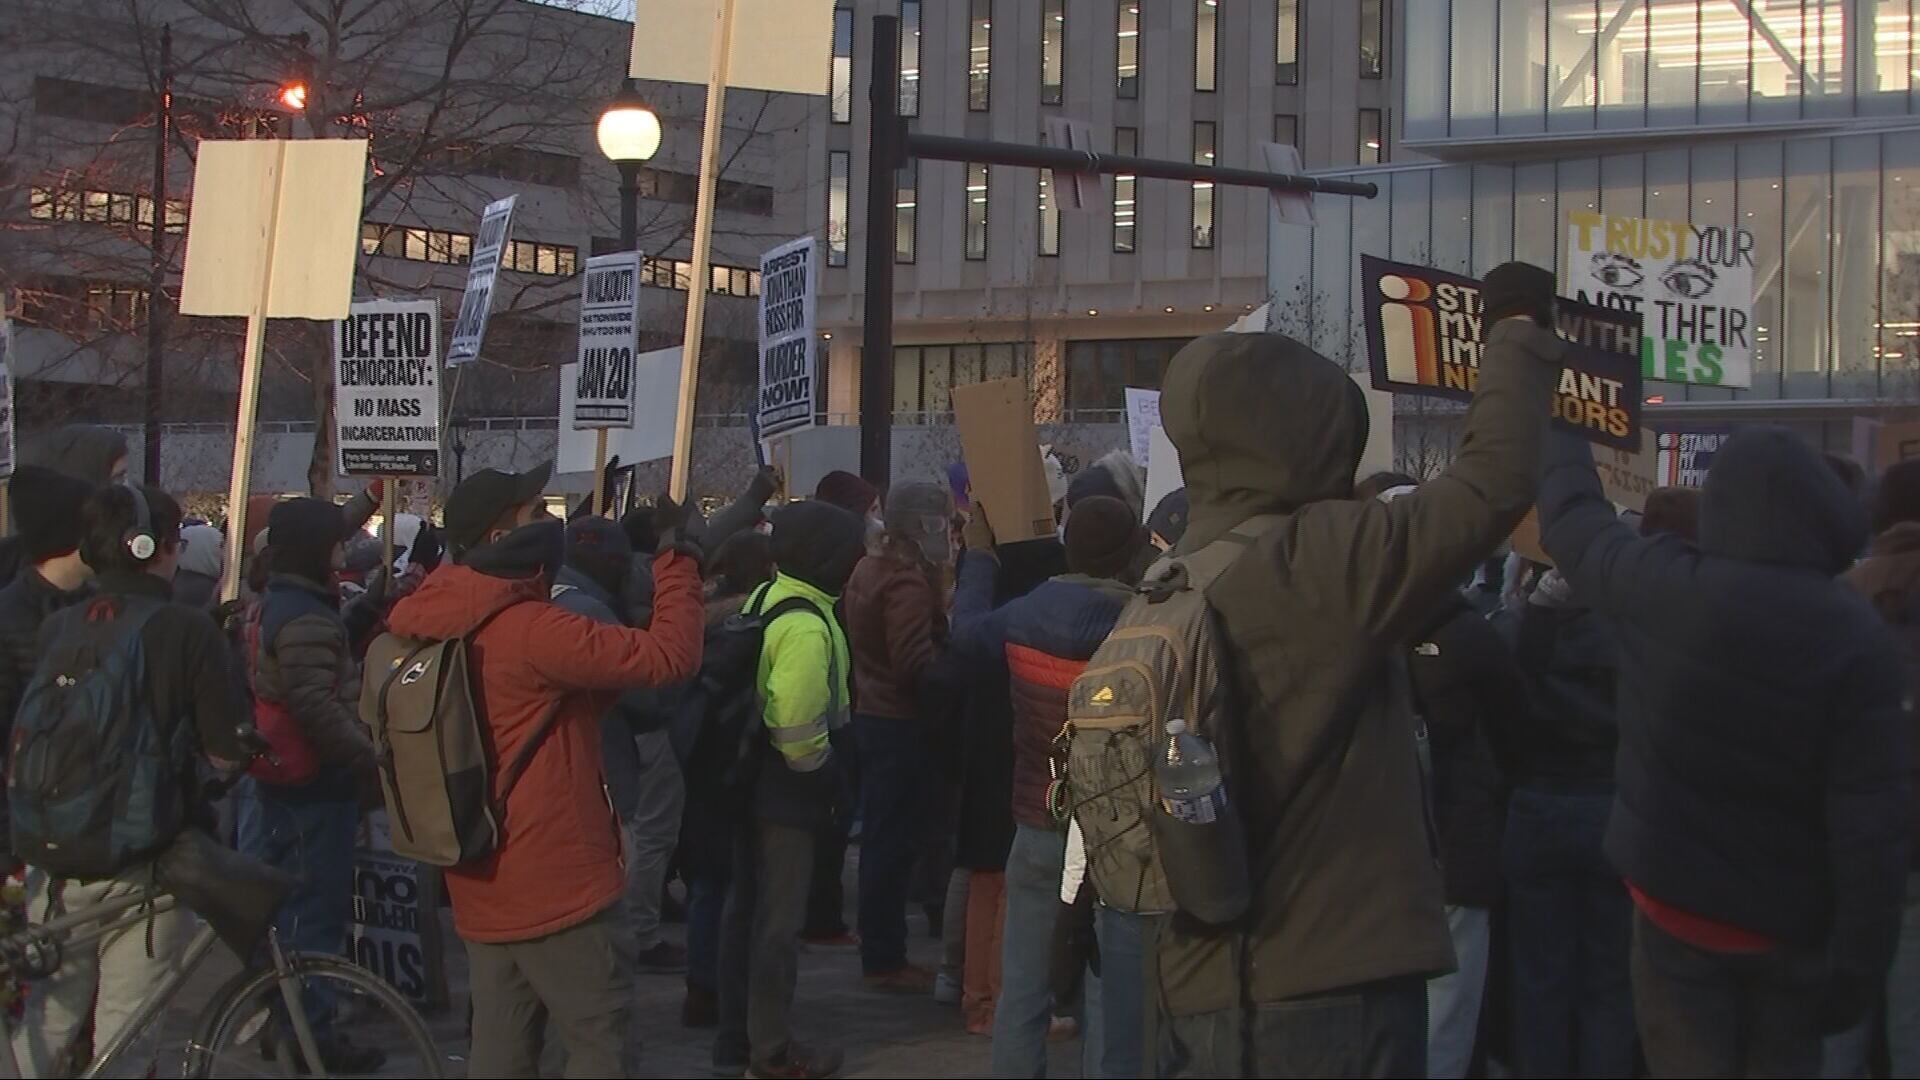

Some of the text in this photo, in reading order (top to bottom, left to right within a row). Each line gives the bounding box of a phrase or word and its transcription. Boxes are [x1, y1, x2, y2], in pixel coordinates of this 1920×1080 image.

[1569, 210, 1754, 267] TRUST YOUR
[763, 247, 810, 276] ARREST
[765, 266, 806, 307] JONATHAN
[341, 312, 431, 358] DEFEND
[766, 298, 805, 337] ROSS FOR
[1439, 310, 1483, 342] MY
[1552, 304, 1638, 355] WITH
[1654, 300, 1748, 349] THEIR
[340, 359, 433, 386] DEMOCRACY:
[577, 347, 630, 399] JAN 20
[765, 337, 806, 386] MURDER
[1643, 337, 1723, 384] IES
[354, 398, 422, 417] NO MASS
[761, 376, 810, 409] NOW!
[341, 426, 437, 442] INCARCERATION!
